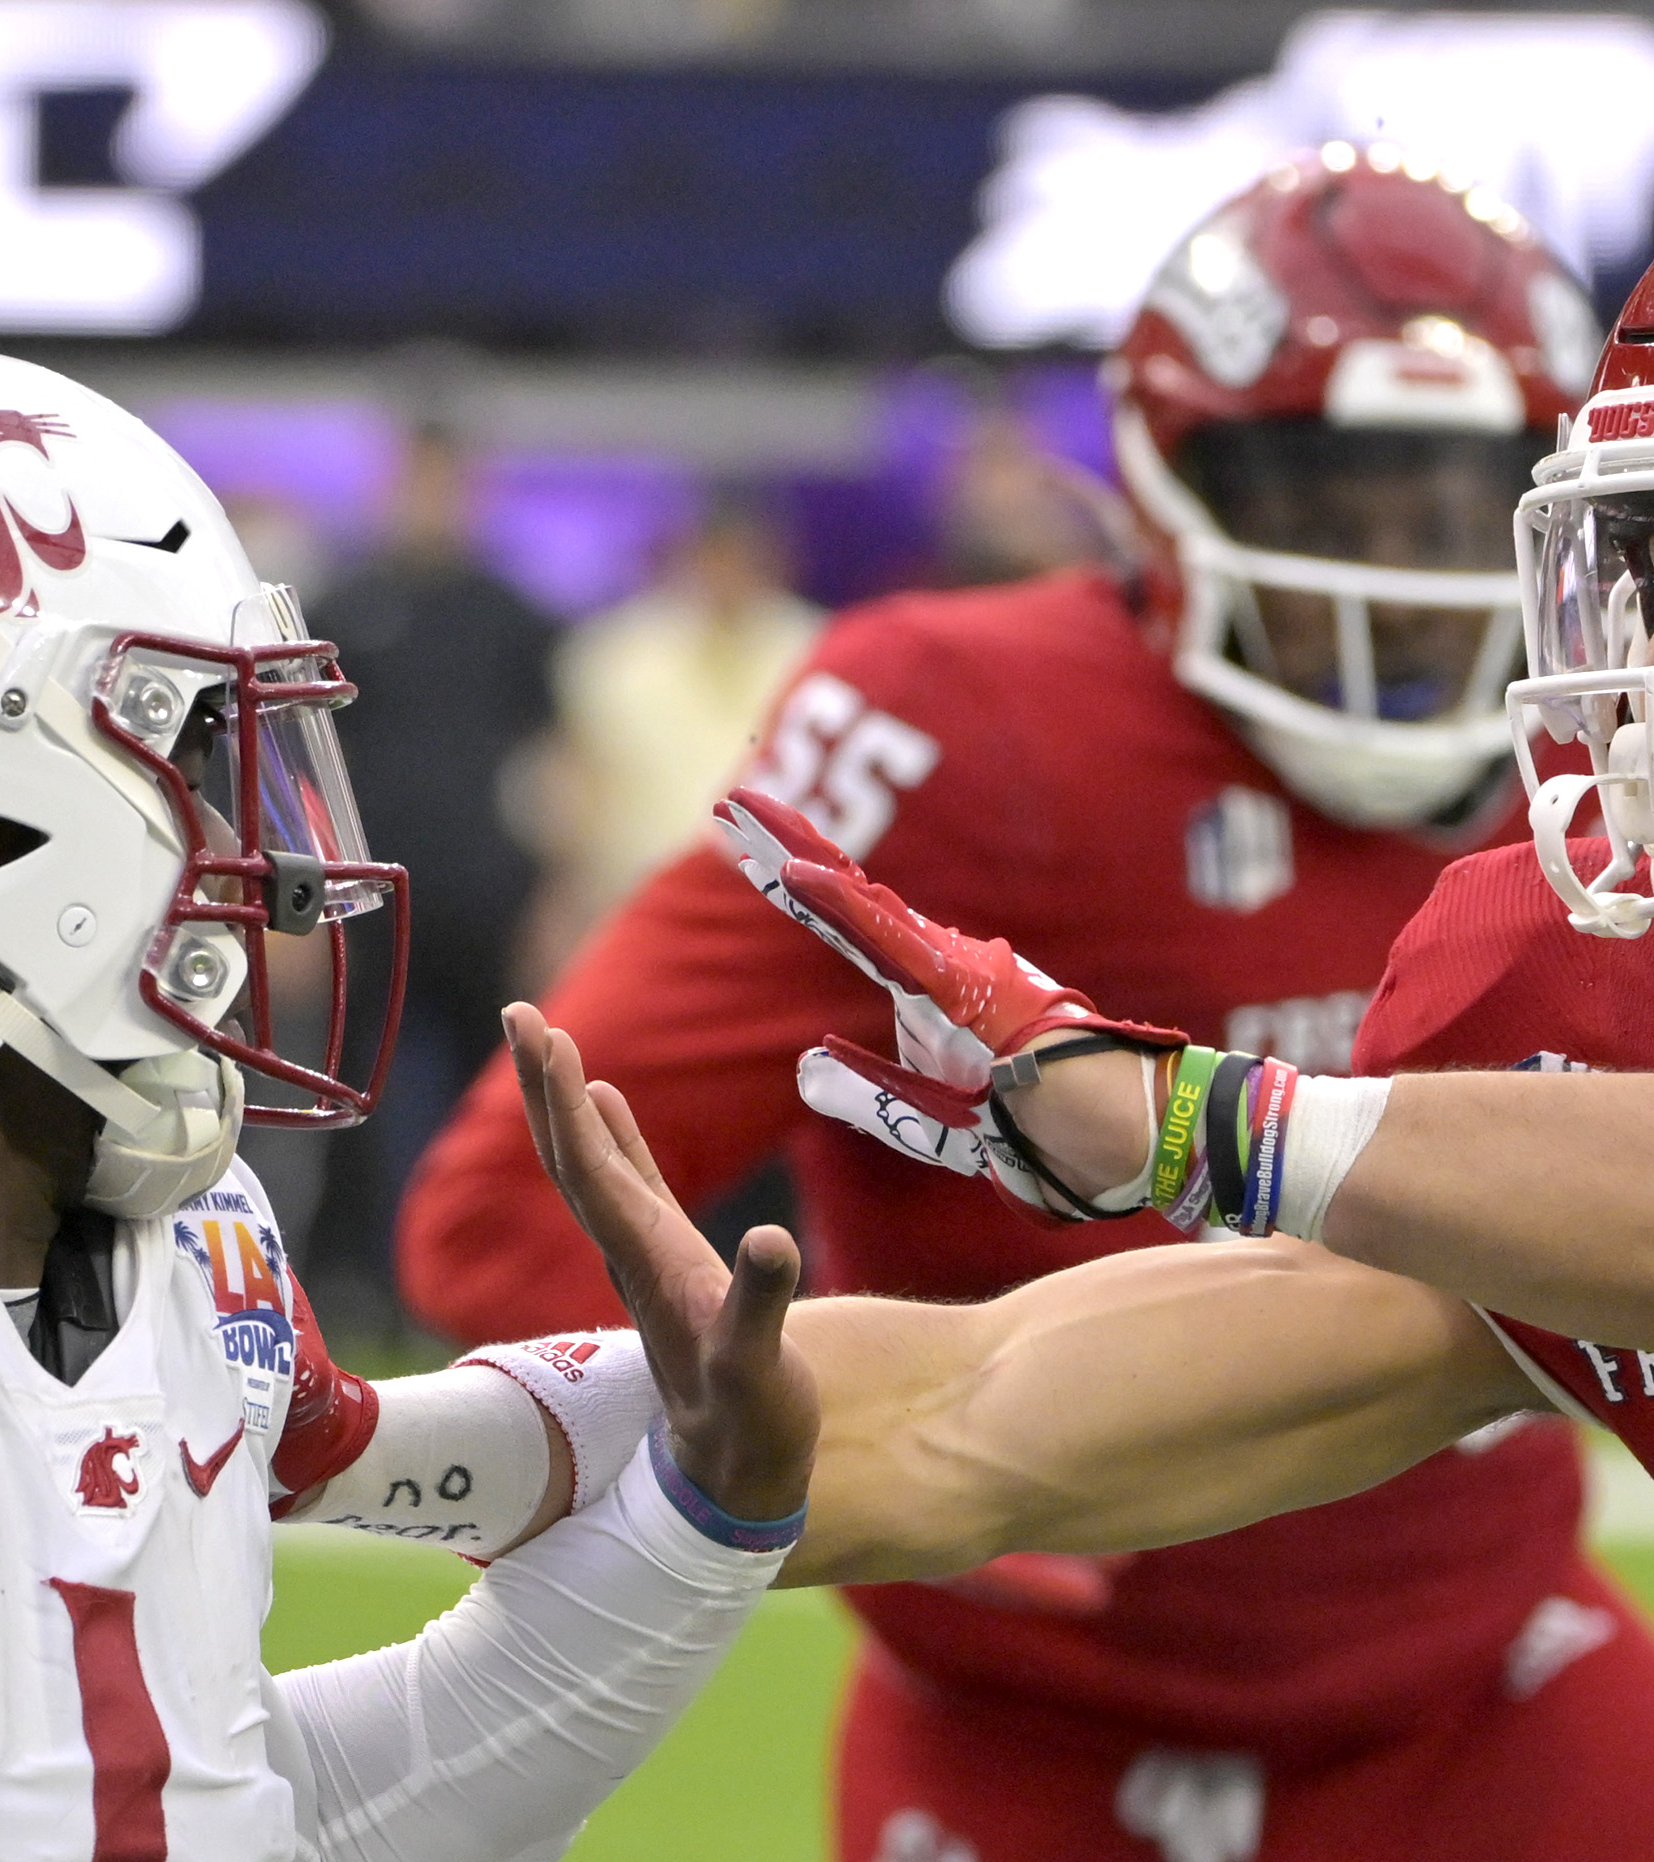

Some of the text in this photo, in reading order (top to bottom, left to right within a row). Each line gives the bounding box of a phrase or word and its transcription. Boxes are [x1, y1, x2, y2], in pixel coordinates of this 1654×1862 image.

[1163, 1081, 1201, 1160] JUICE
[210, 1192, 254, 1214] KIMMEL
[1154, 1163, 1180, 1200] THE
[202, 1220, 286, 1317] LA
[222, 1325, 291, 1376] BOWL
[520, 1342, 585, 1383] didas
